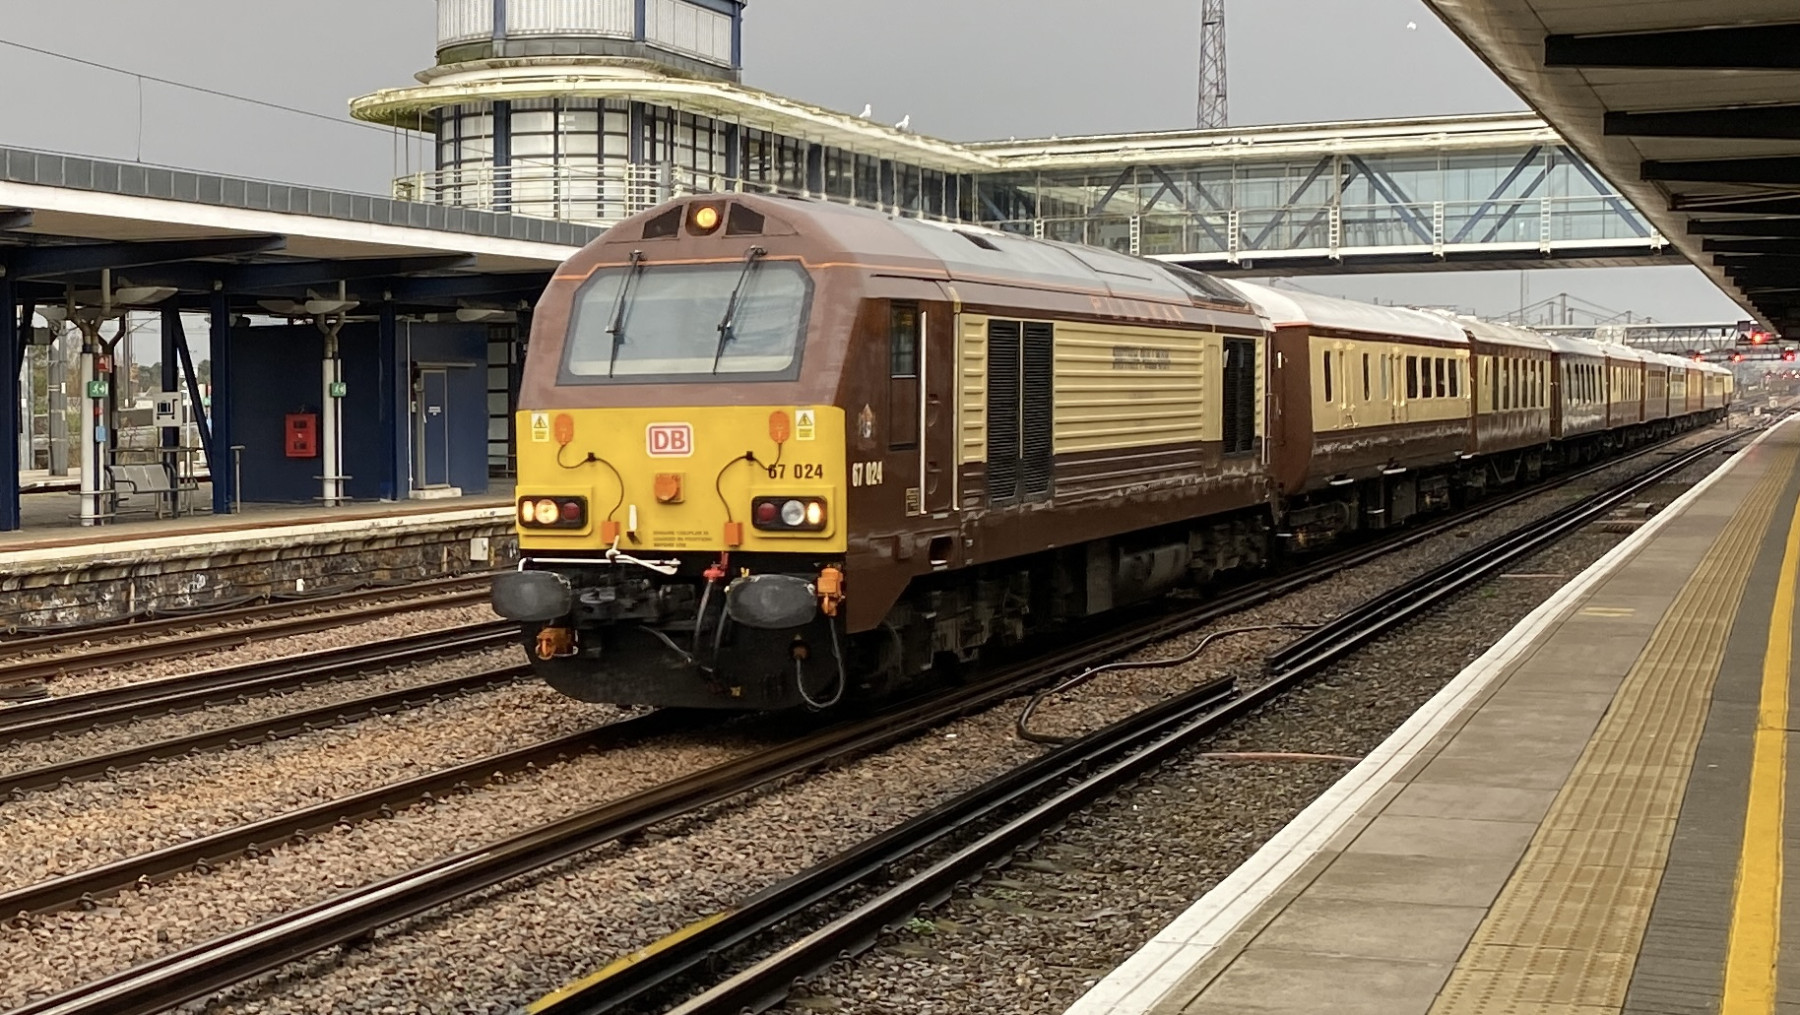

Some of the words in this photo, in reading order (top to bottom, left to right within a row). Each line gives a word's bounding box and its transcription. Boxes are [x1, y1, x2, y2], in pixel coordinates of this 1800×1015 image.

[654, 430, 686, 450] DB
[768, 463, 786, 480] 67
[794, 463, 824, 480] 024
[852, 462, 864, 488] 67
[865, 460, 883, 486] 024
